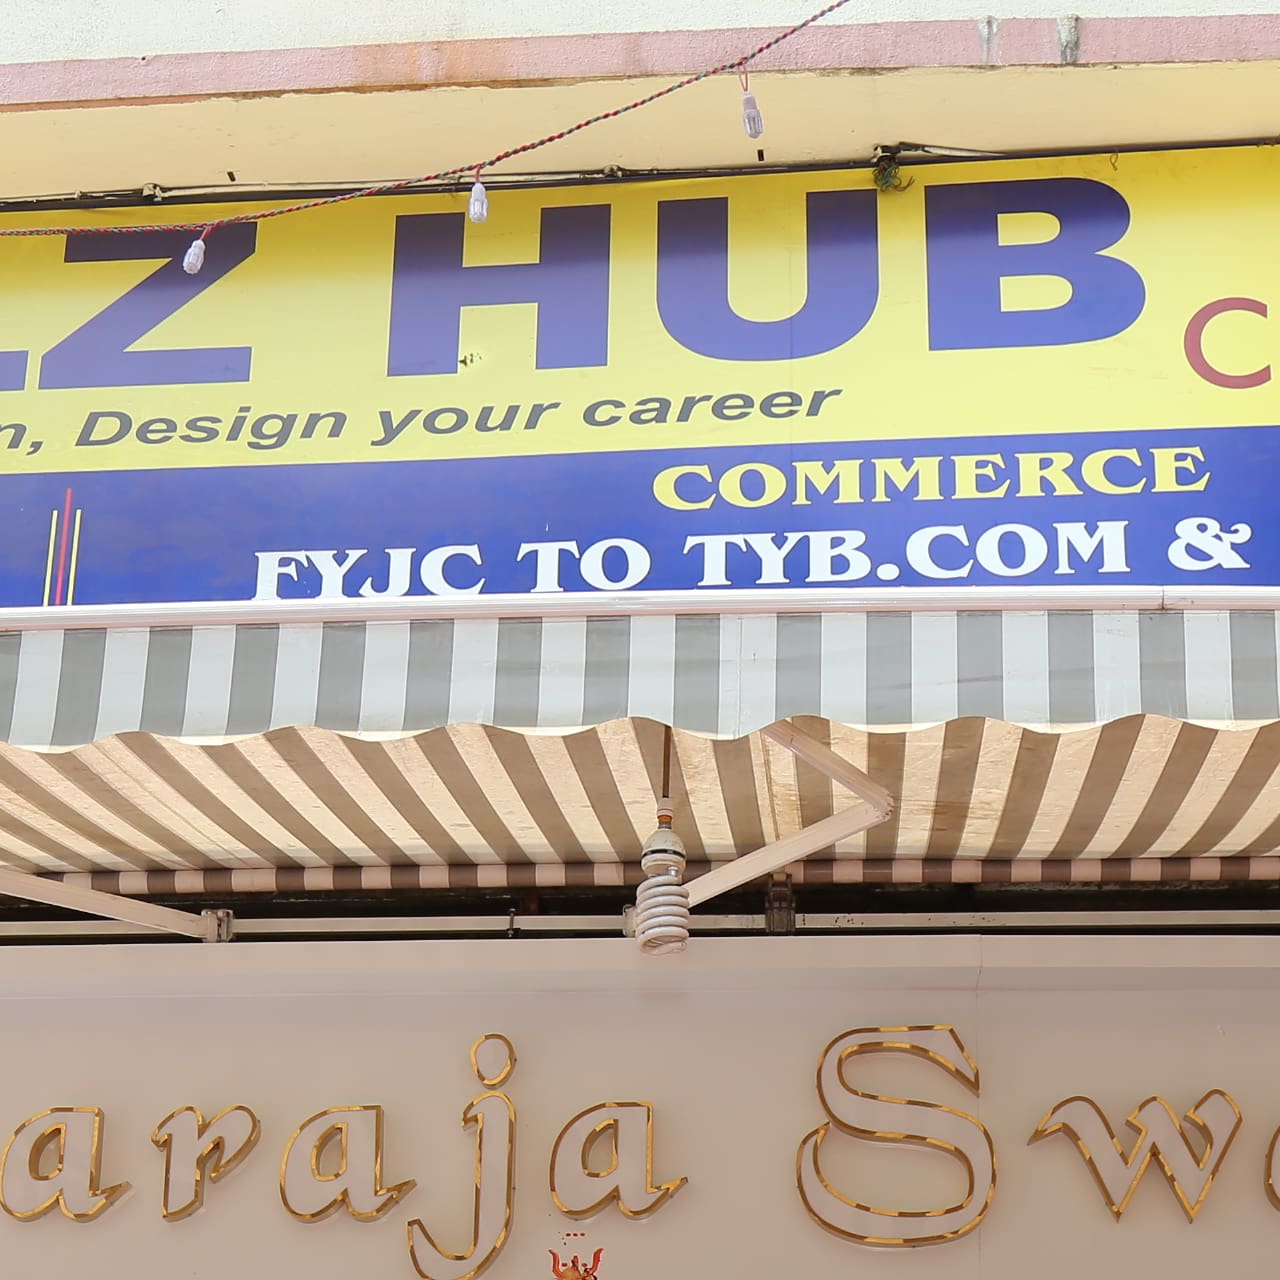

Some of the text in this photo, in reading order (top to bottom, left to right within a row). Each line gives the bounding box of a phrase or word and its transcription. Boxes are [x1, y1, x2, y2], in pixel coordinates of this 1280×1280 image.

[387, 176, 1147, 377] HUB
[75, 406, 348, 452] Design
[369, 400, 562, 447] your
[581, 387, 844, 429] career
[652, 445, 1212, 512] COMMERCE
[253, 543, 487, 601] FYJC
[517, 537, 652, 594] TO
[683, 520, 1132, 588] TYB.COM
[1166, 515, 1252, 571] &
